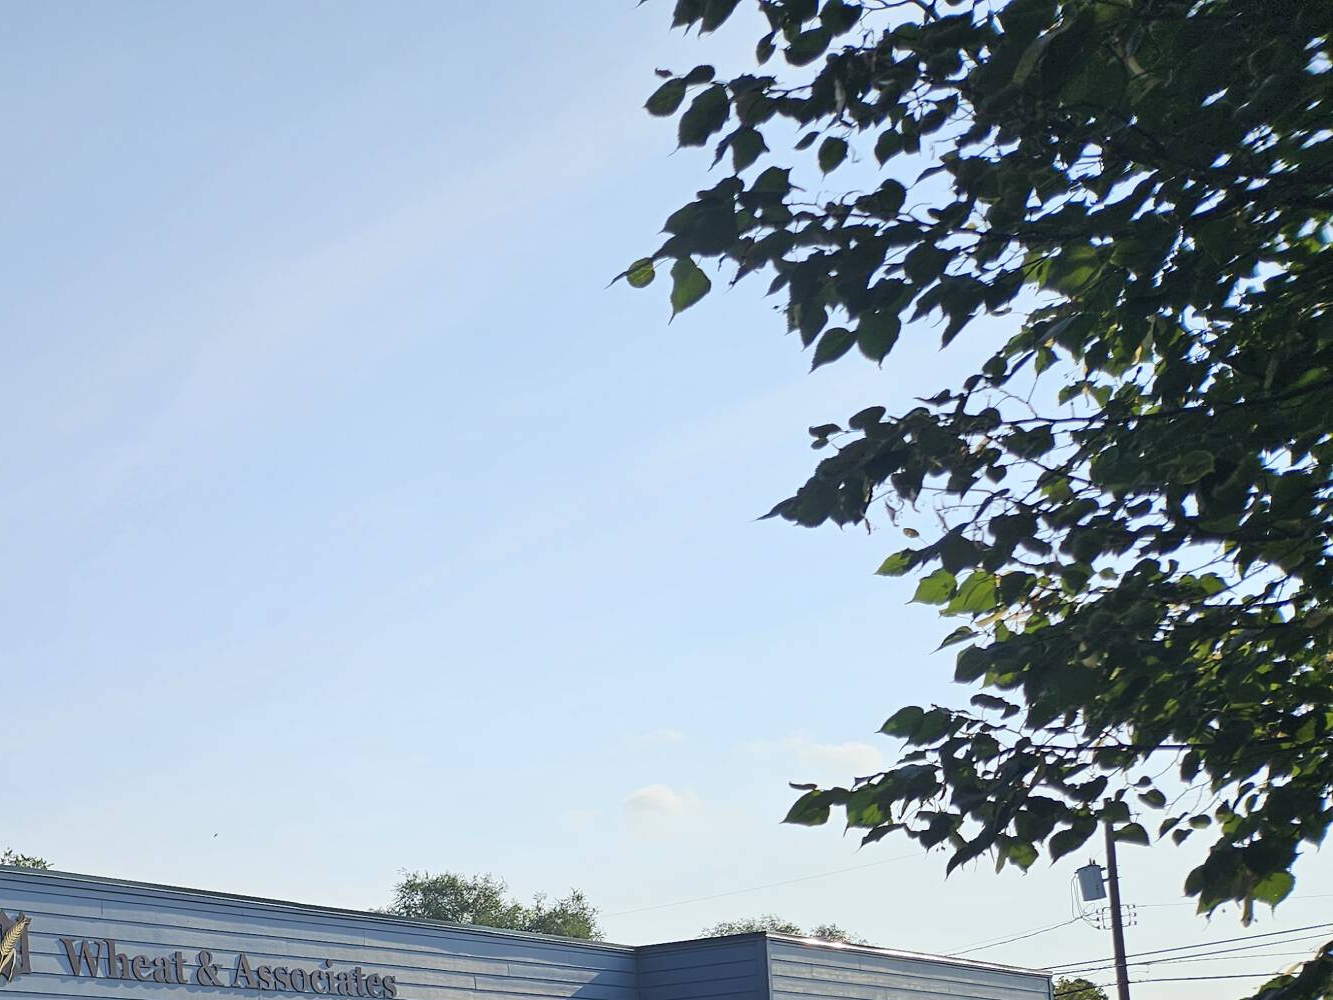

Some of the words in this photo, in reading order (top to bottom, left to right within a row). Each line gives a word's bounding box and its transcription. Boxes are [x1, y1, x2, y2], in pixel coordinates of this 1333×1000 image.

[59, 937, 188, 985] Wheat
[197, 949, 225, 987] &
[233, 952, 398, 999] Associates
